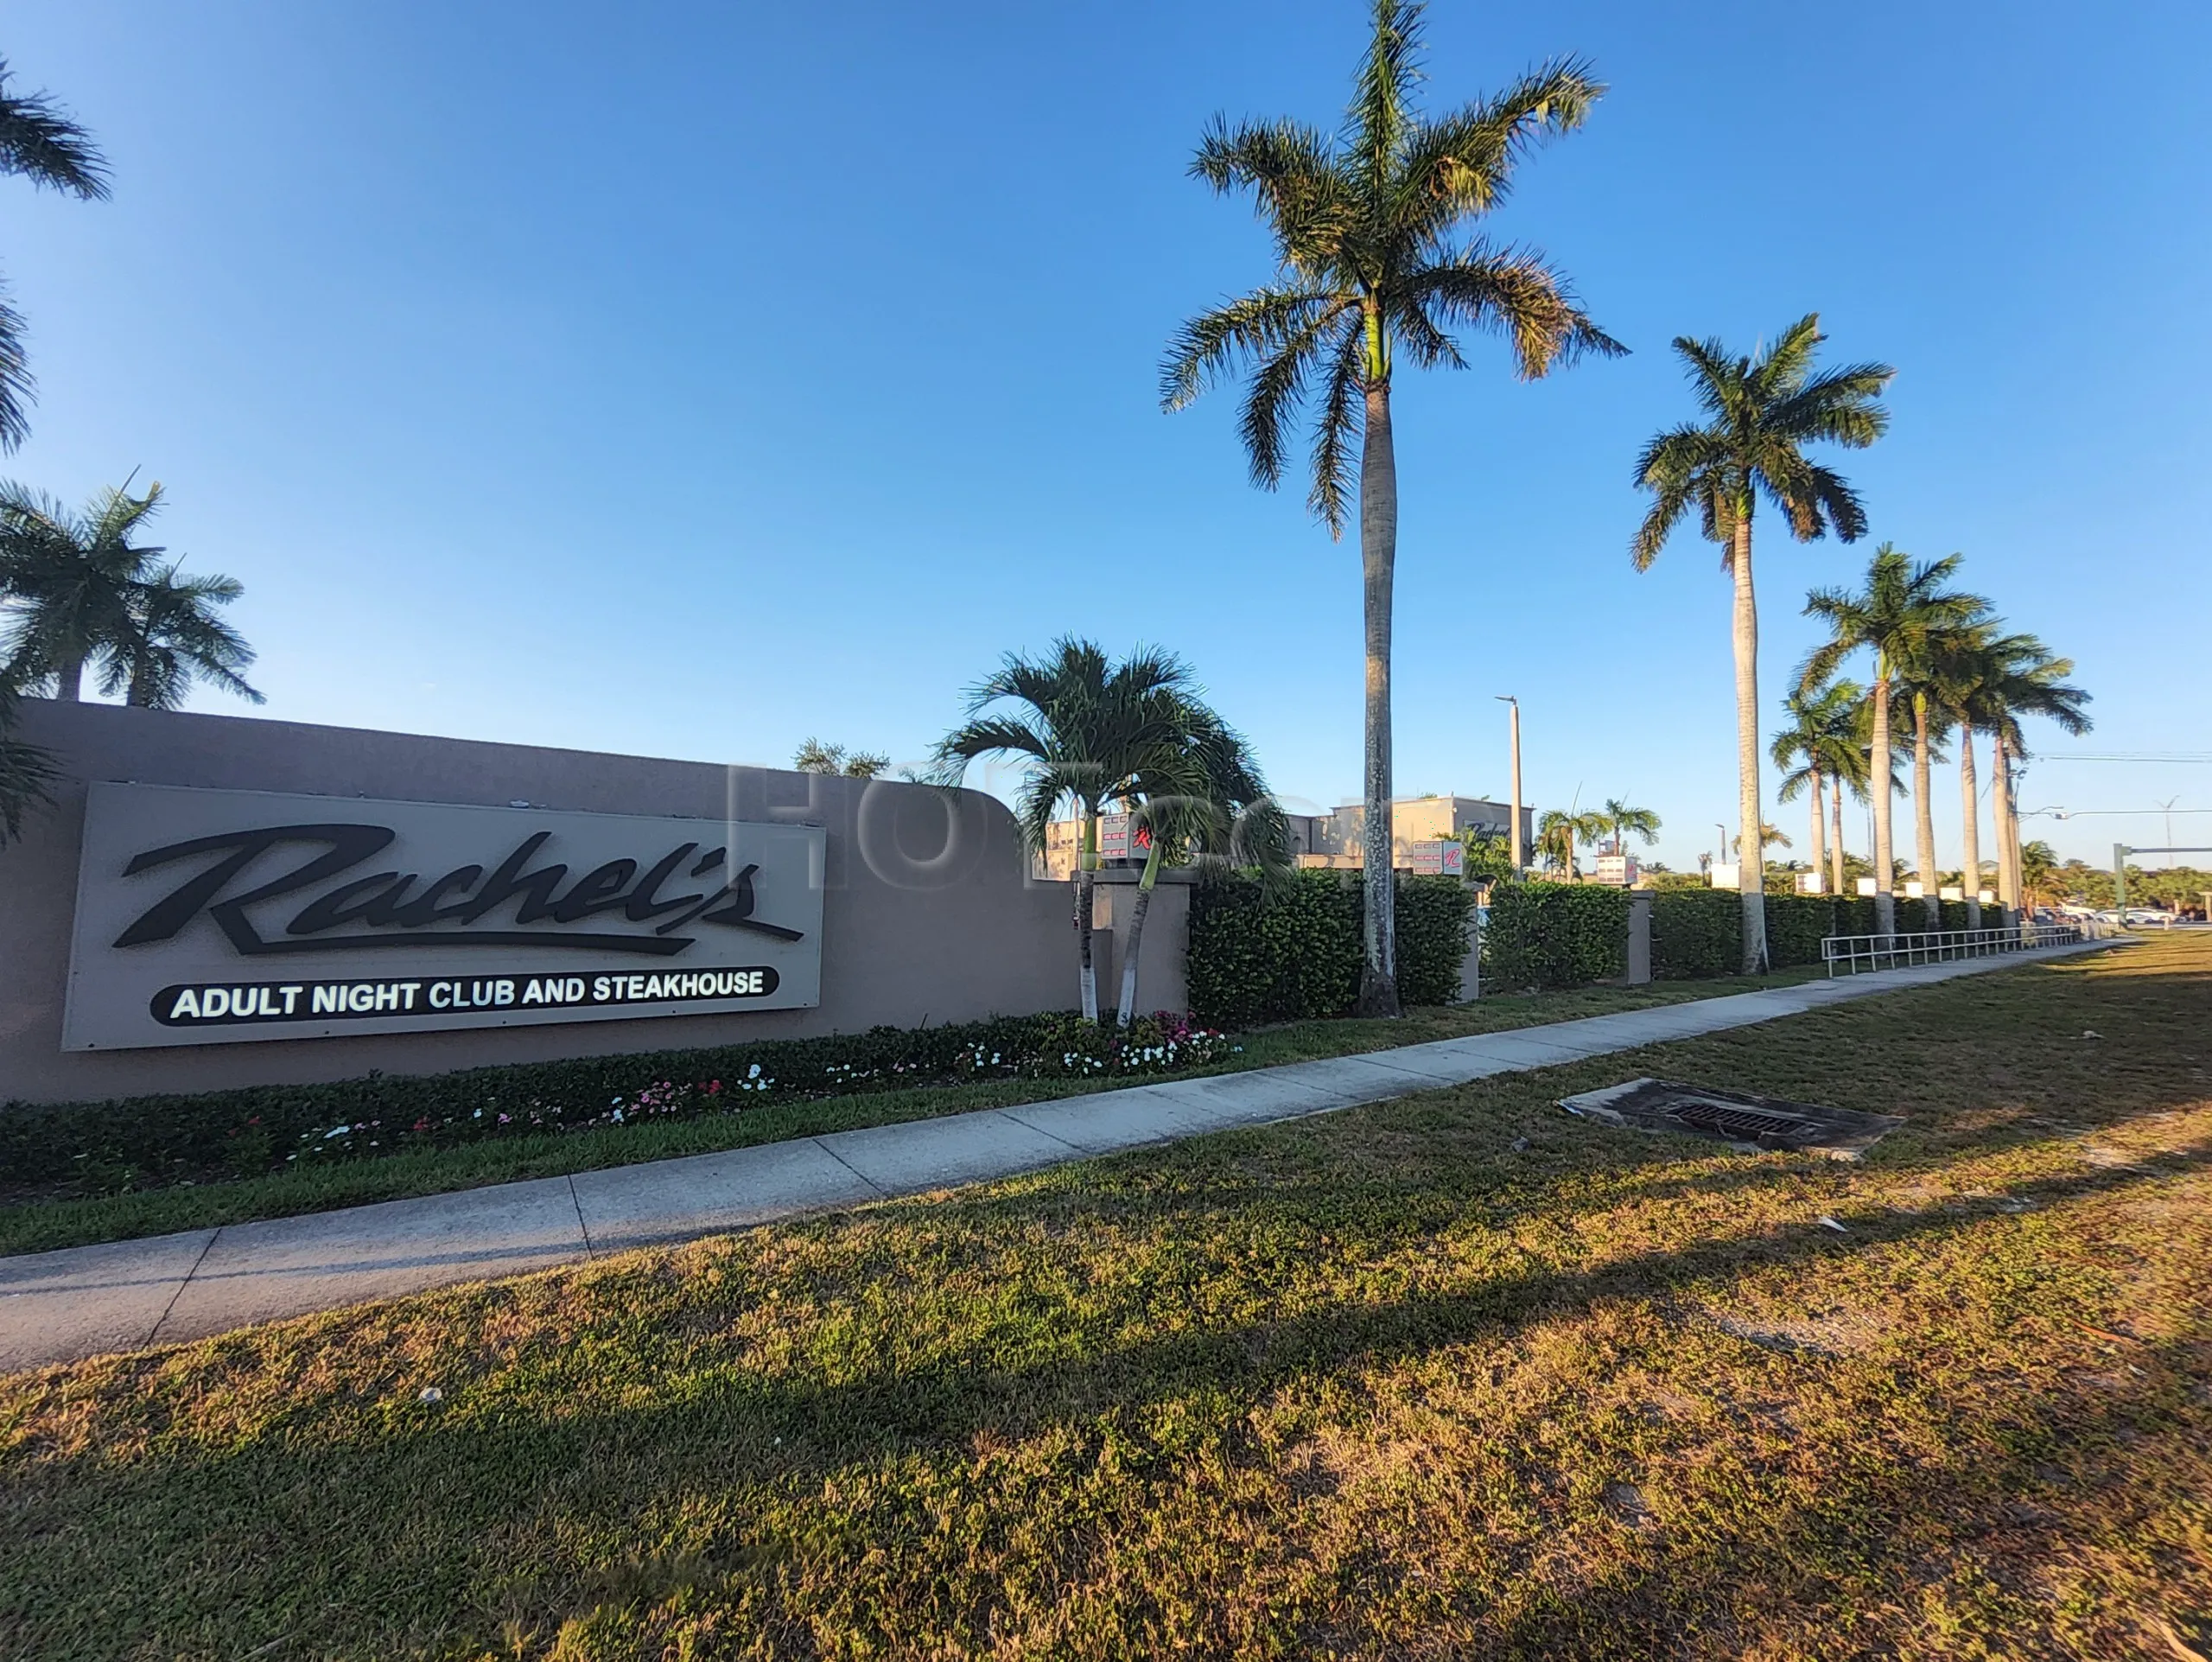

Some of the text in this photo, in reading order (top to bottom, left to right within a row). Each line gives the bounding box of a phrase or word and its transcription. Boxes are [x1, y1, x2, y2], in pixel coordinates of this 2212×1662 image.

[112, 823, 804, 956] Rachel's
[169, 971, 764, 1019] ADULT NIGHT CLUB AND STEAKHOUSE
